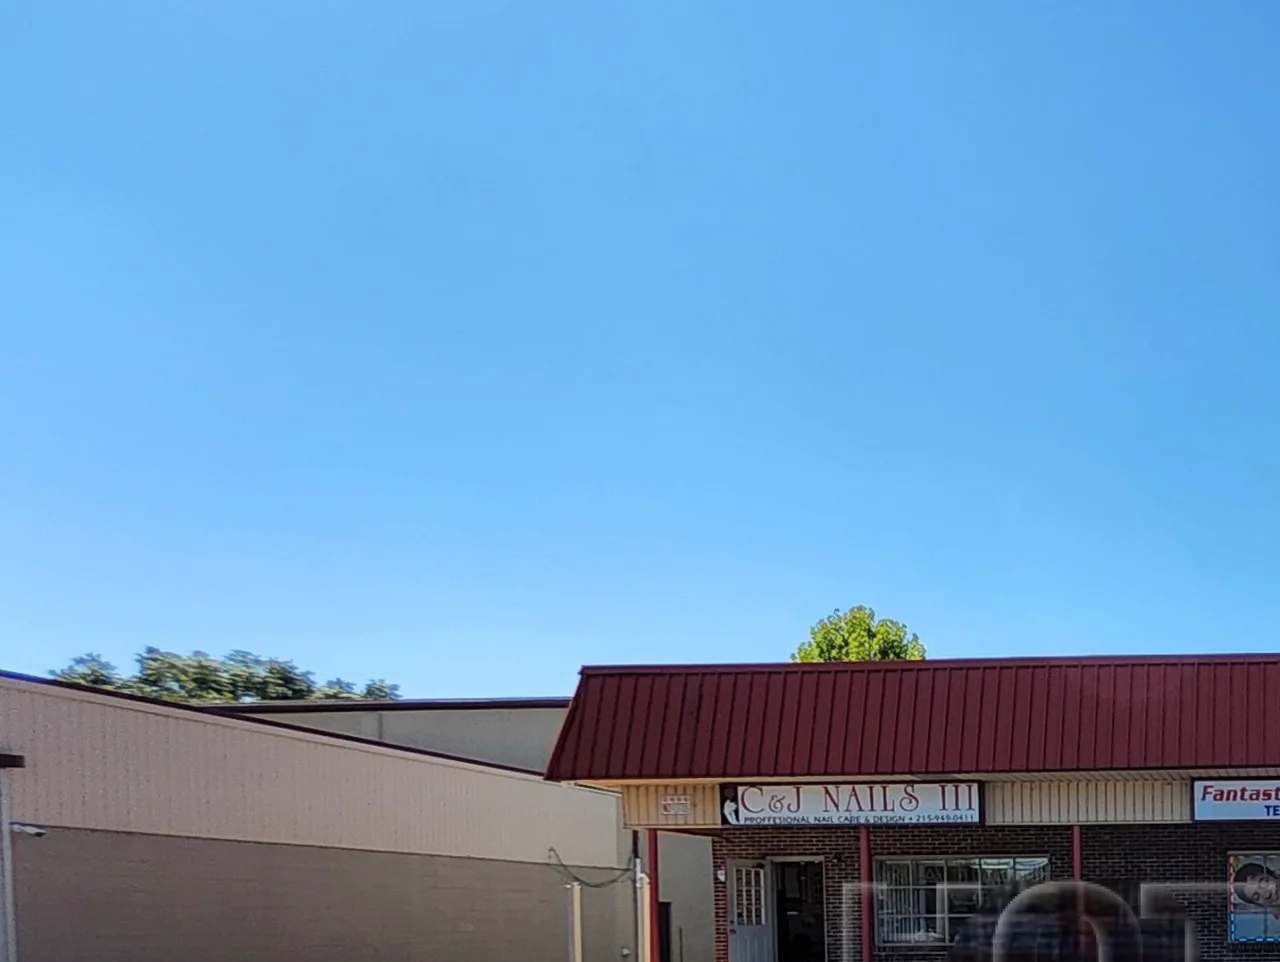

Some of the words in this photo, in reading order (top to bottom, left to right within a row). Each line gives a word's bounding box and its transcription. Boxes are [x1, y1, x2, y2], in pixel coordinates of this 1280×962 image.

[741, 785, 801, 814] C&J
[822, 784, 919, 812] NAILS
[938, 784, 976, 811] III
[744, 816, 812, 824] PROFFESIONAL
[814, 816, 834, 824] NAIL
[873, 815, 906, 823] DESIGN
